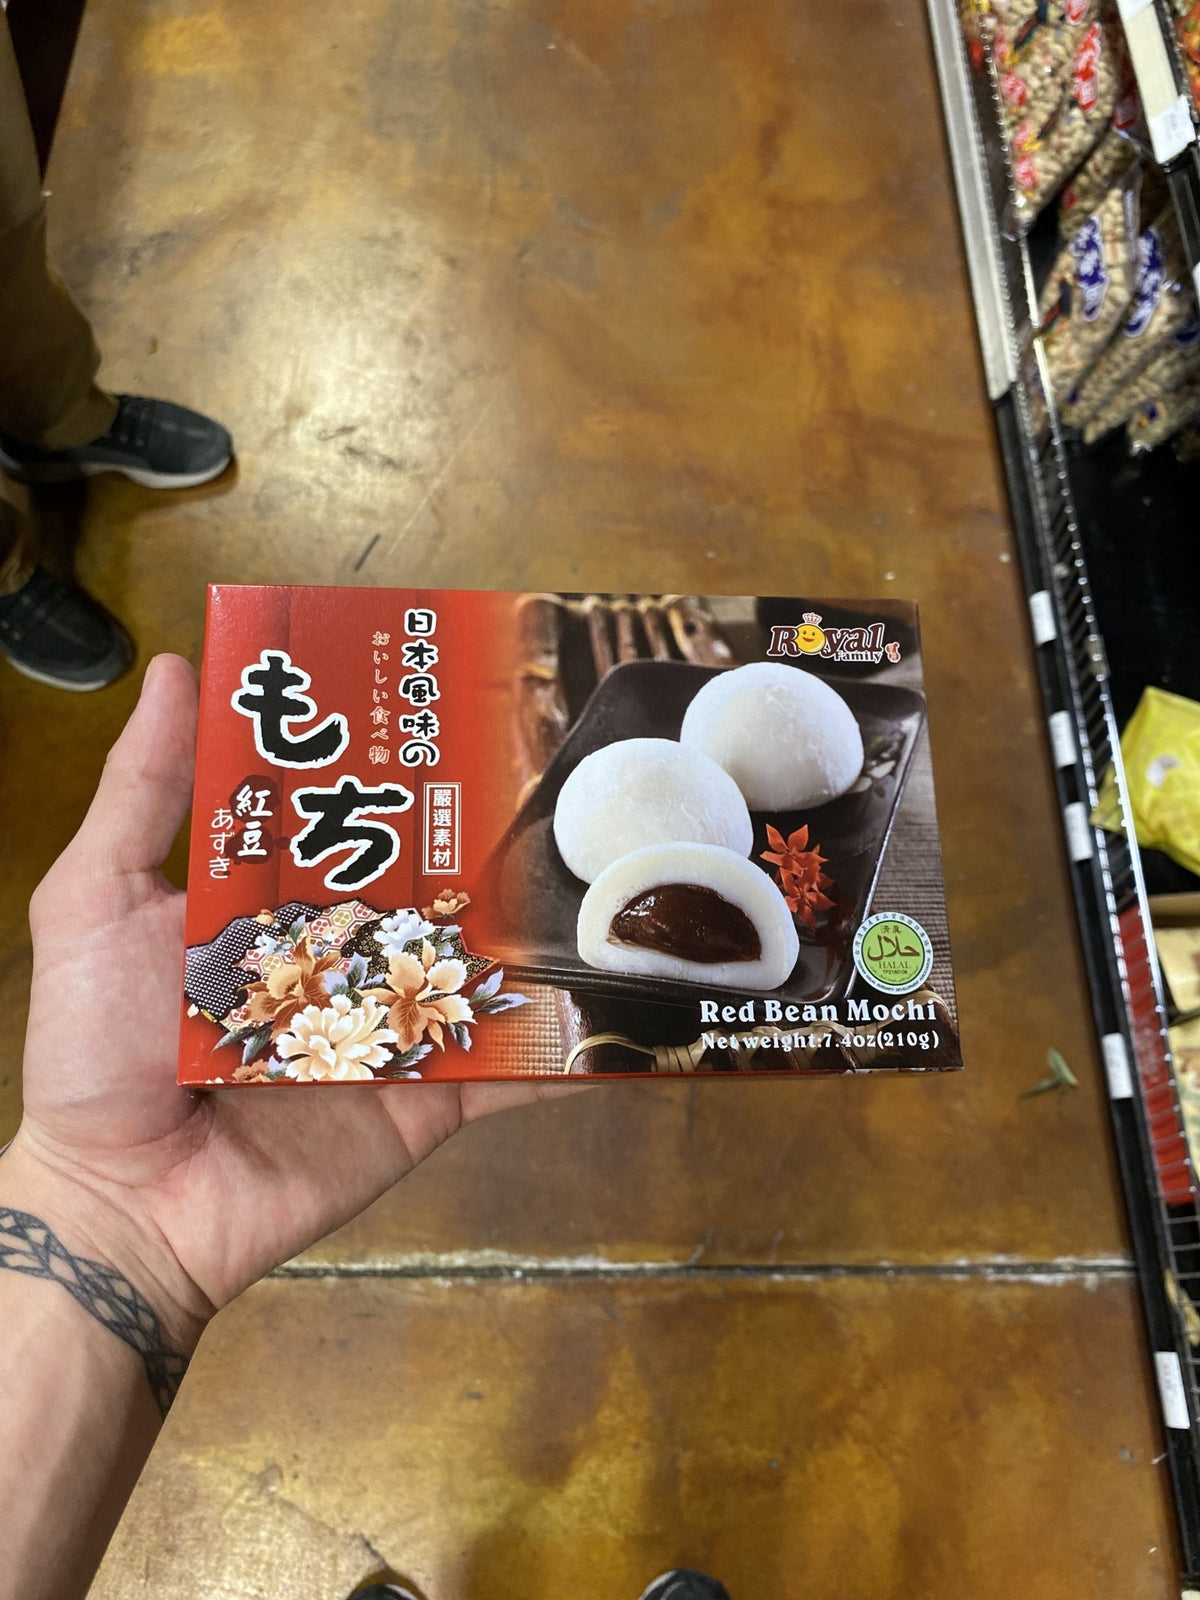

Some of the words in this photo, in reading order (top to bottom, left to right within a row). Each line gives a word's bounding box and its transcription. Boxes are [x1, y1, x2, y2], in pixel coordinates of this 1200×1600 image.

[767, 622, 885, 659] Royal
[834, 651, 883, 664] Family
[368, 631, 391, 764] おいしい食べ物
[399, 608, 441, 767] 日本風味の
[208, 807, 236, 879] あずき
[235, 784, 273, 857] 紅豆
[432, 788, 452, 868] 嚴選素材
[878, 960, 910, 969] HALAL
[700, 1000, 755, 1022] Red
[764, 999, 838, 1022] Bean
[847, 999, 936, 1021] Mochi
[701, 1032, 739, 1049] Net
